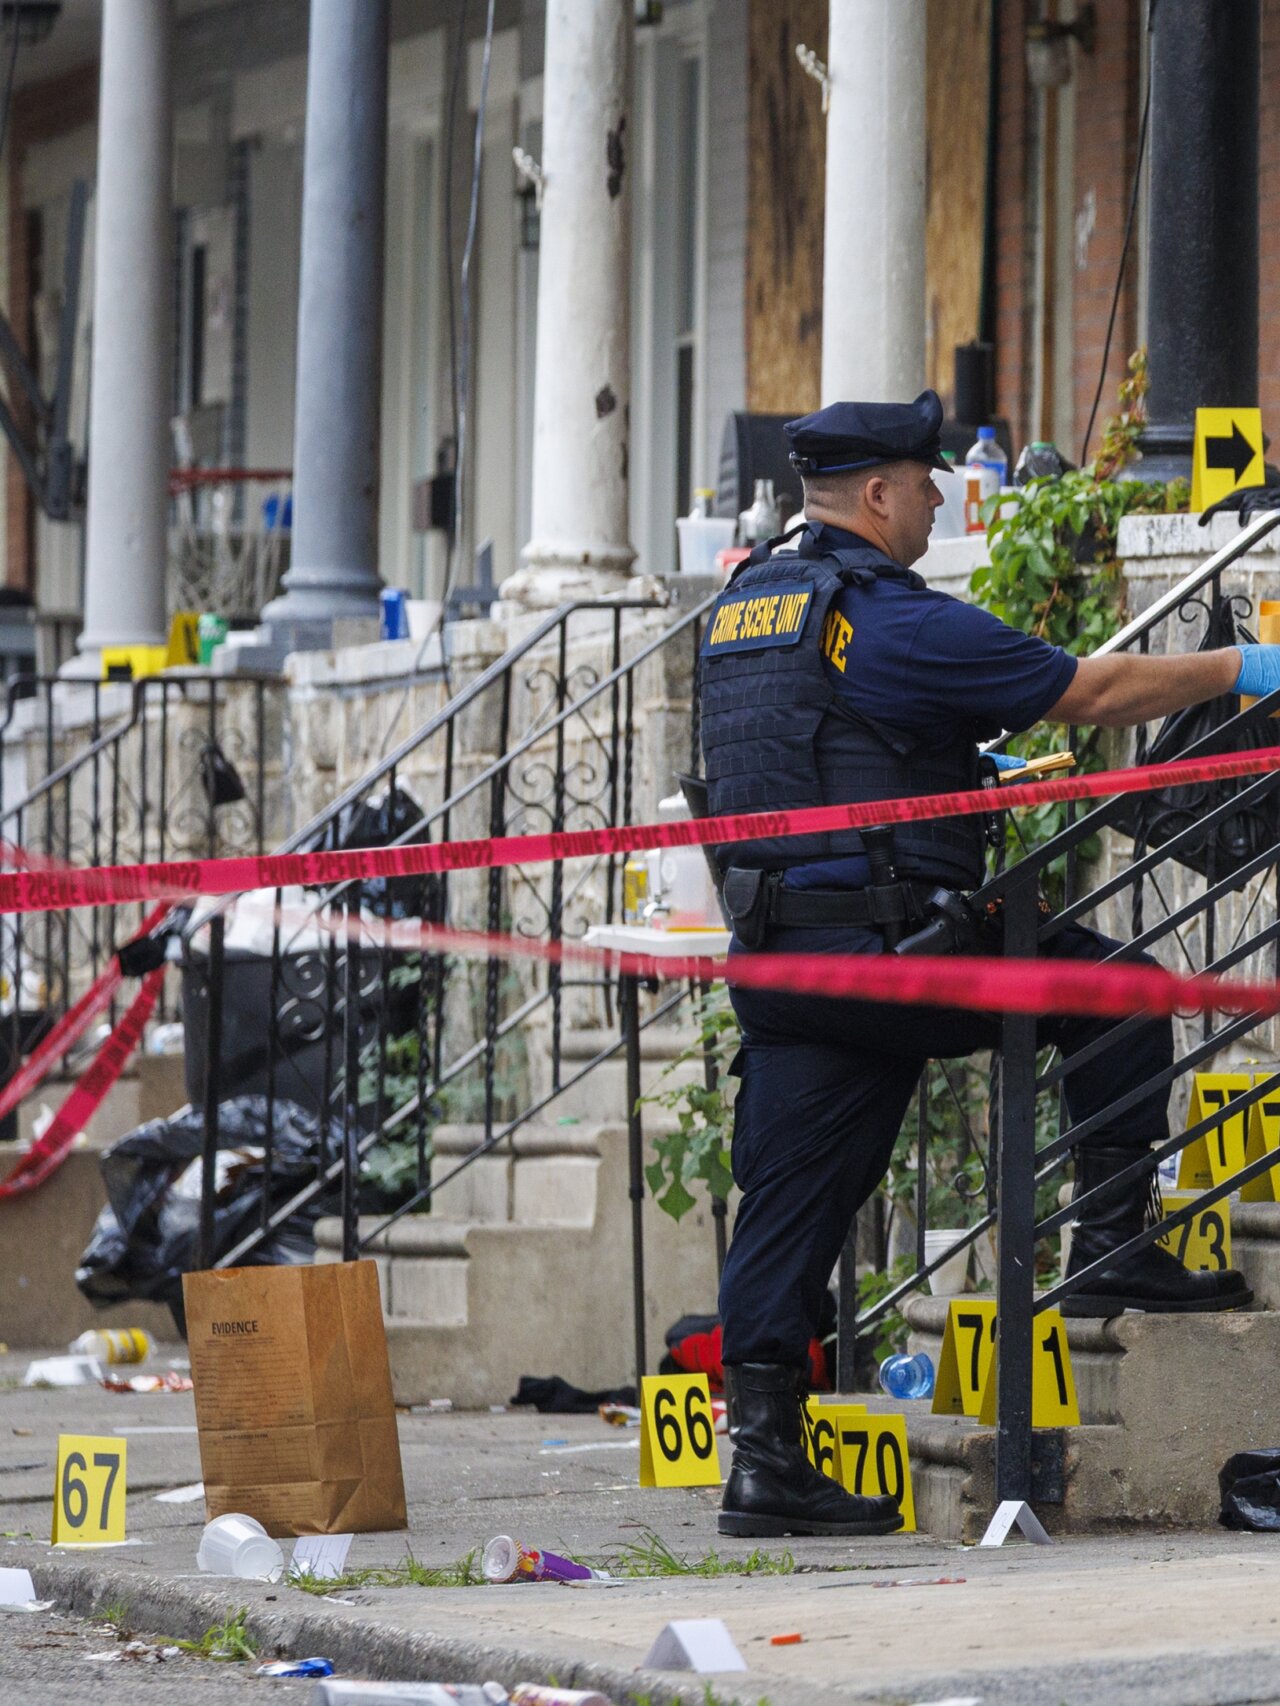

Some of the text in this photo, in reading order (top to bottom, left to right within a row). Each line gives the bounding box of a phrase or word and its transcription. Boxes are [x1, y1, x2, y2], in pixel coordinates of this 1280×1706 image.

[710, 592, 810, 646] CRIME SCENE UNIT
[1165, 1211, 1228, 1271] 73
[212, 1320, 259, 1335] EVIDENCE
[957, 1314, 997, 1392] 7
[1042, 1326, 1068, 1406] 1
[654, 1386, 713, 1462] 66
[62, 1451, 120, 1531] 67
[841, 1431, 905, 1507] 70
